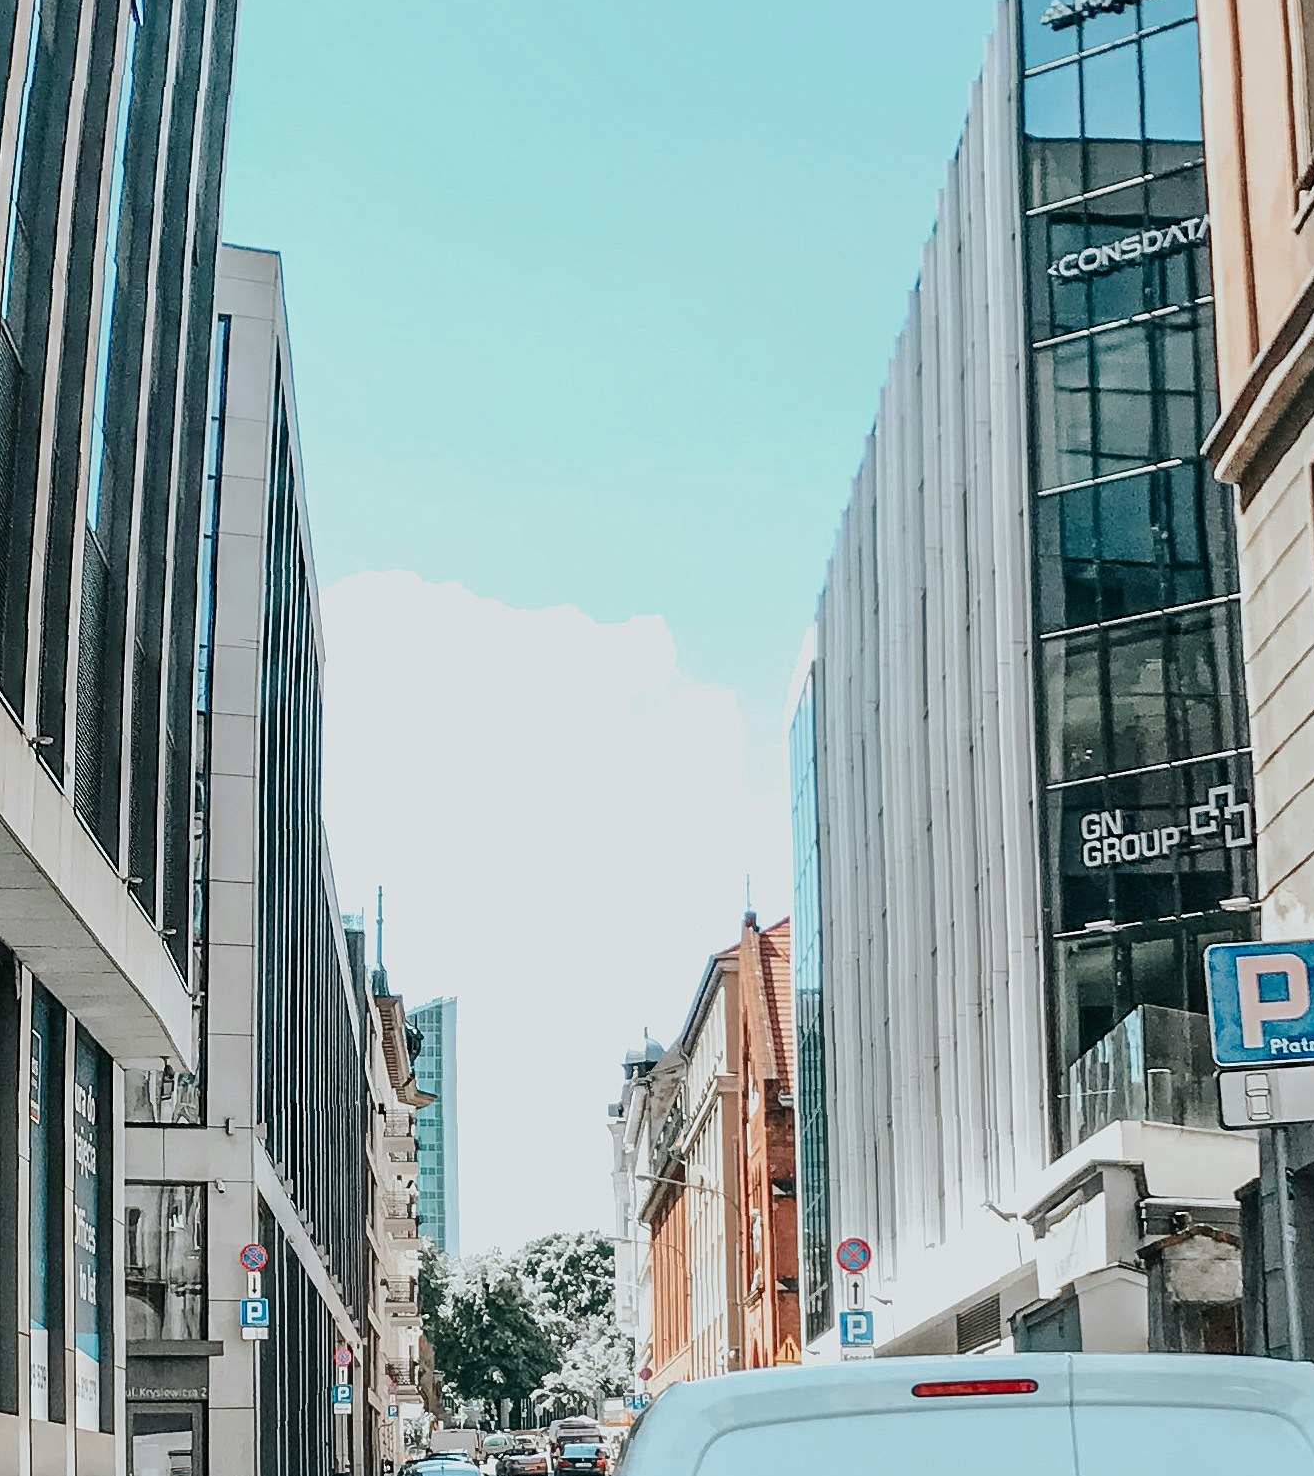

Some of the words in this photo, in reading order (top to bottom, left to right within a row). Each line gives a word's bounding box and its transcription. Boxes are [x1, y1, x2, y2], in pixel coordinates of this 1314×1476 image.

[1080, 808, 1124, 840] GN
[1082, 826, 1181, 868] GROUP
[1236, 953, 1311, 1049] P
[247, 1302, 263, 1323] P
[846, 1314, 868, 1343] P
[201, 1386, 207, 1397] 2
[338, 1386, 350, 1402] P
